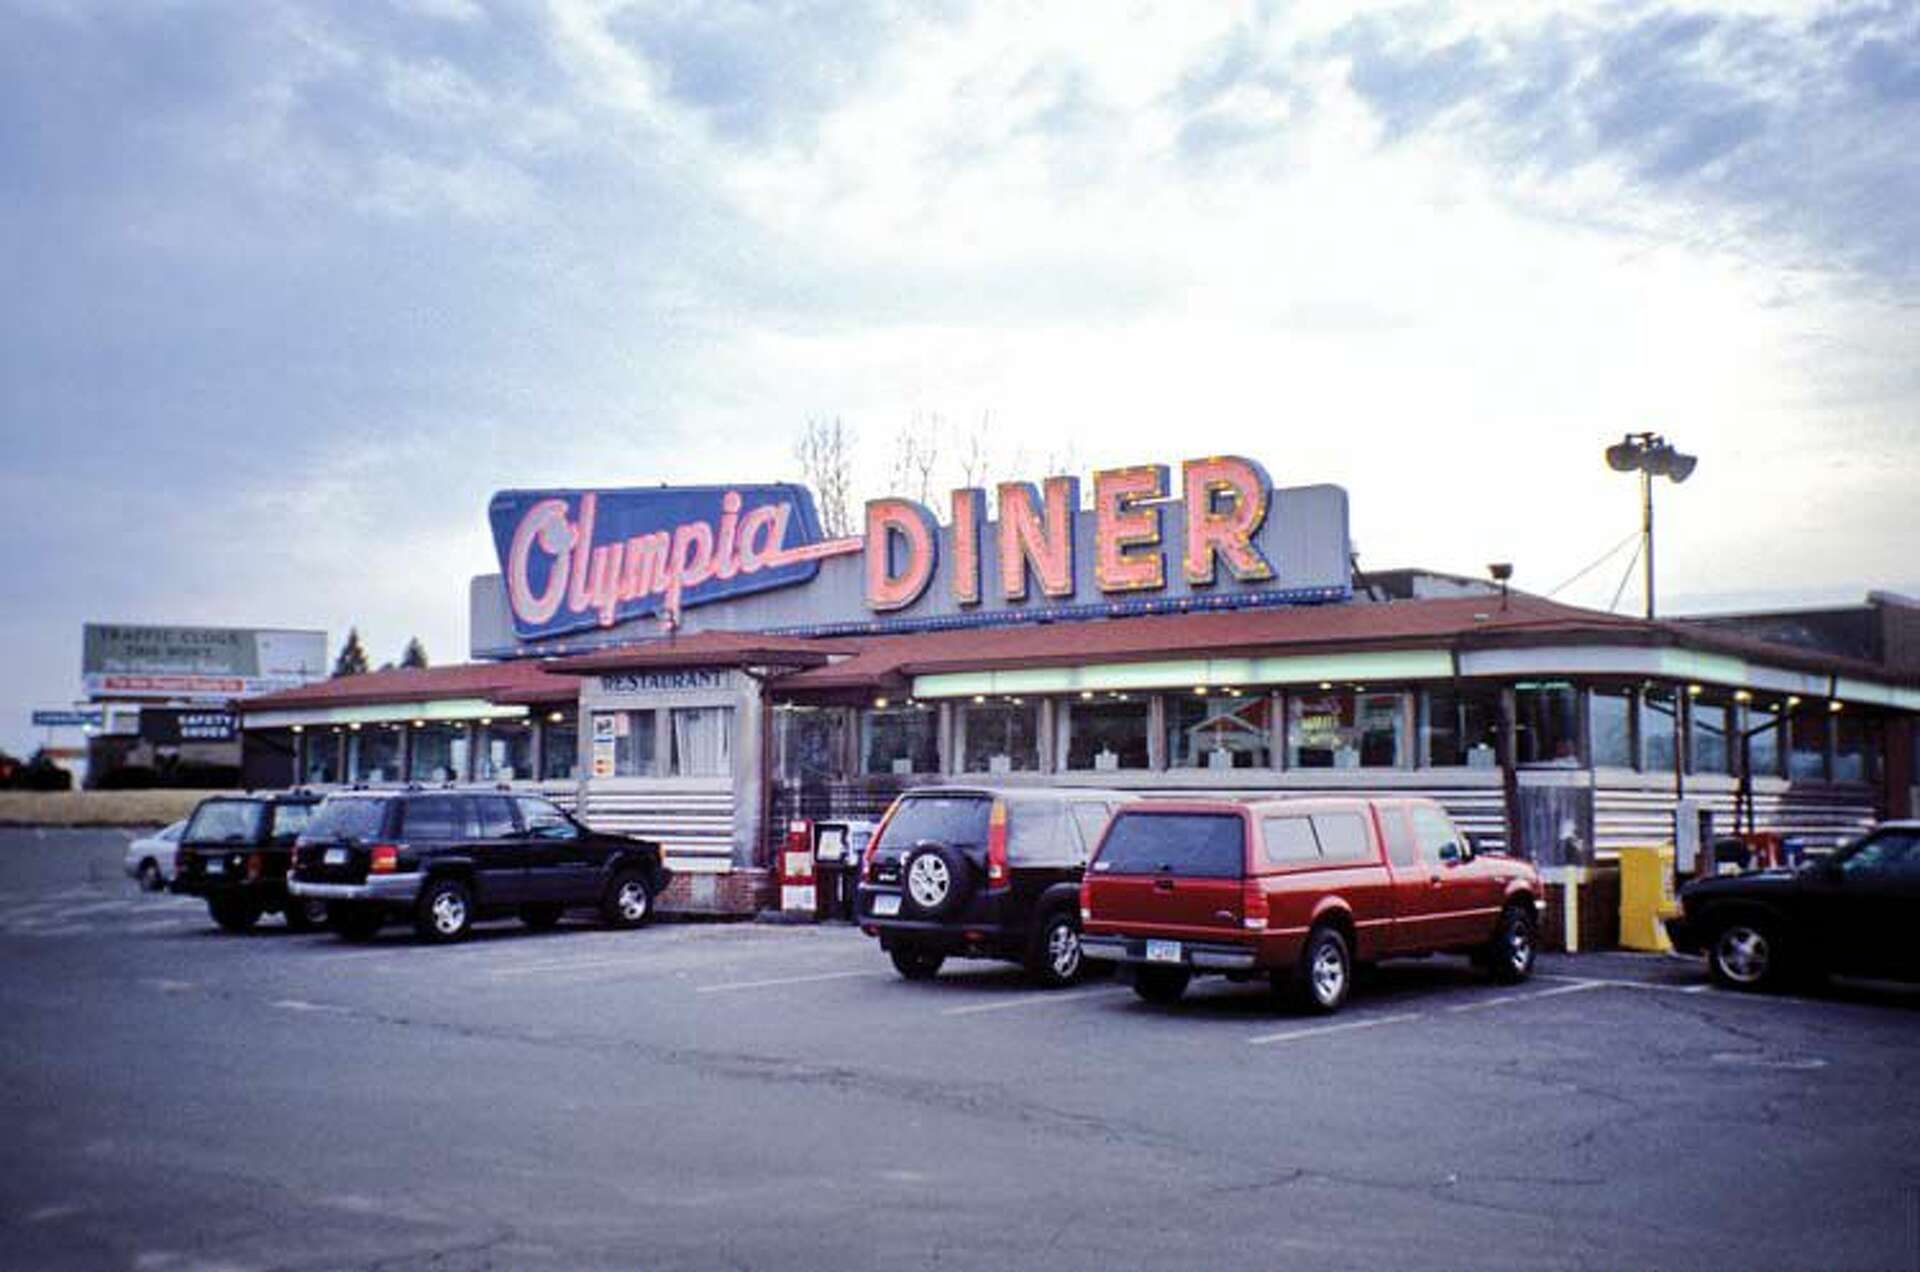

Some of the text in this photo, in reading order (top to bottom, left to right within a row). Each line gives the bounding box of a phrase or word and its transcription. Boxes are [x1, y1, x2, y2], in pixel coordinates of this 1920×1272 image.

[508, 455, 1276, 629] Olympia DINER
[101, 626, 238, 646] TRAFFIC CLOGS
[602, 670, 721, 692] RESTAURANT
[178, 714, 232, 726] SAFETY
